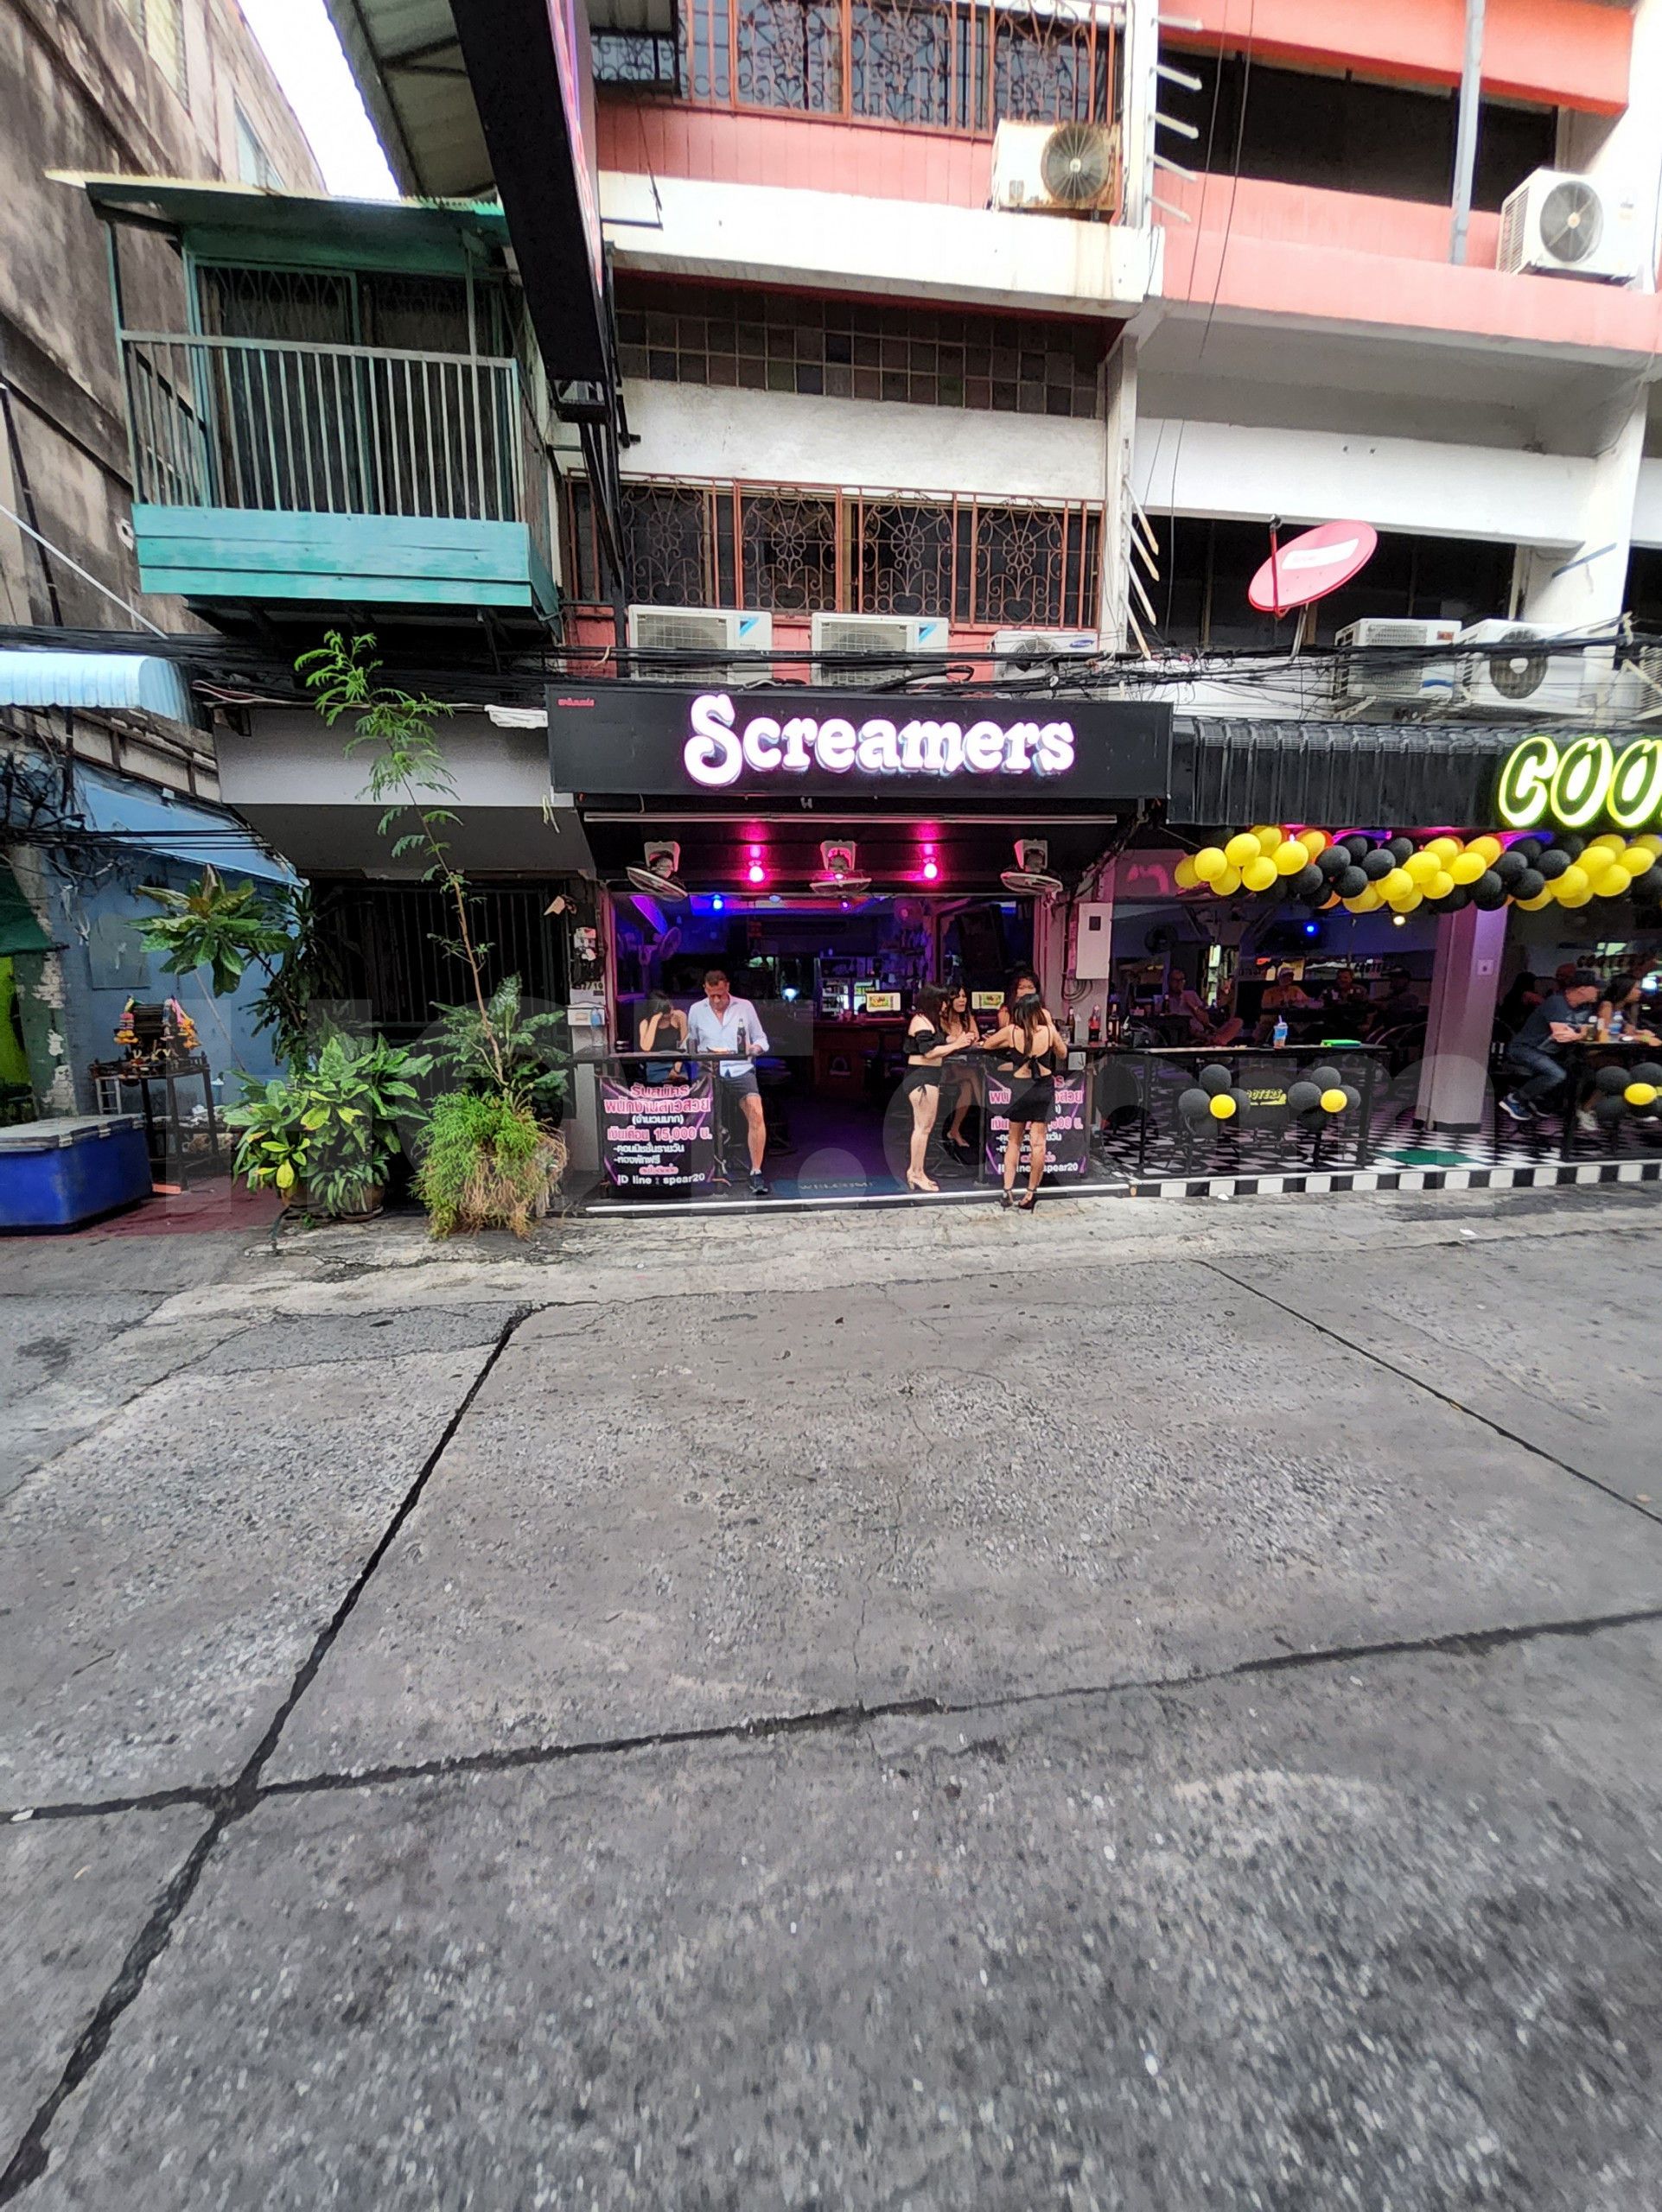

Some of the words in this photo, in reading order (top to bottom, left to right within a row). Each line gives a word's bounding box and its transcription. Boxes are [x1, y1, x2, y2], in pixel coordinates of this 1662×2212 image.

[682, 693, 1076, 786] Screamers
[1498, 735, 1662, 828] COO
[631, 1083, 690, 1098] รับสมัคร
[604, 1096, 710, 1114] พนักงานสาวสวย
[632, 1114, 685, 1125] (จำนวนมาก)
[607, 1125, 650, 1141] เงินเดือน
[653, 1126, 697, 1143] 15,000
[632, 1175, 653, 1185] line
[663, 1173, 705, 1186] spear20
